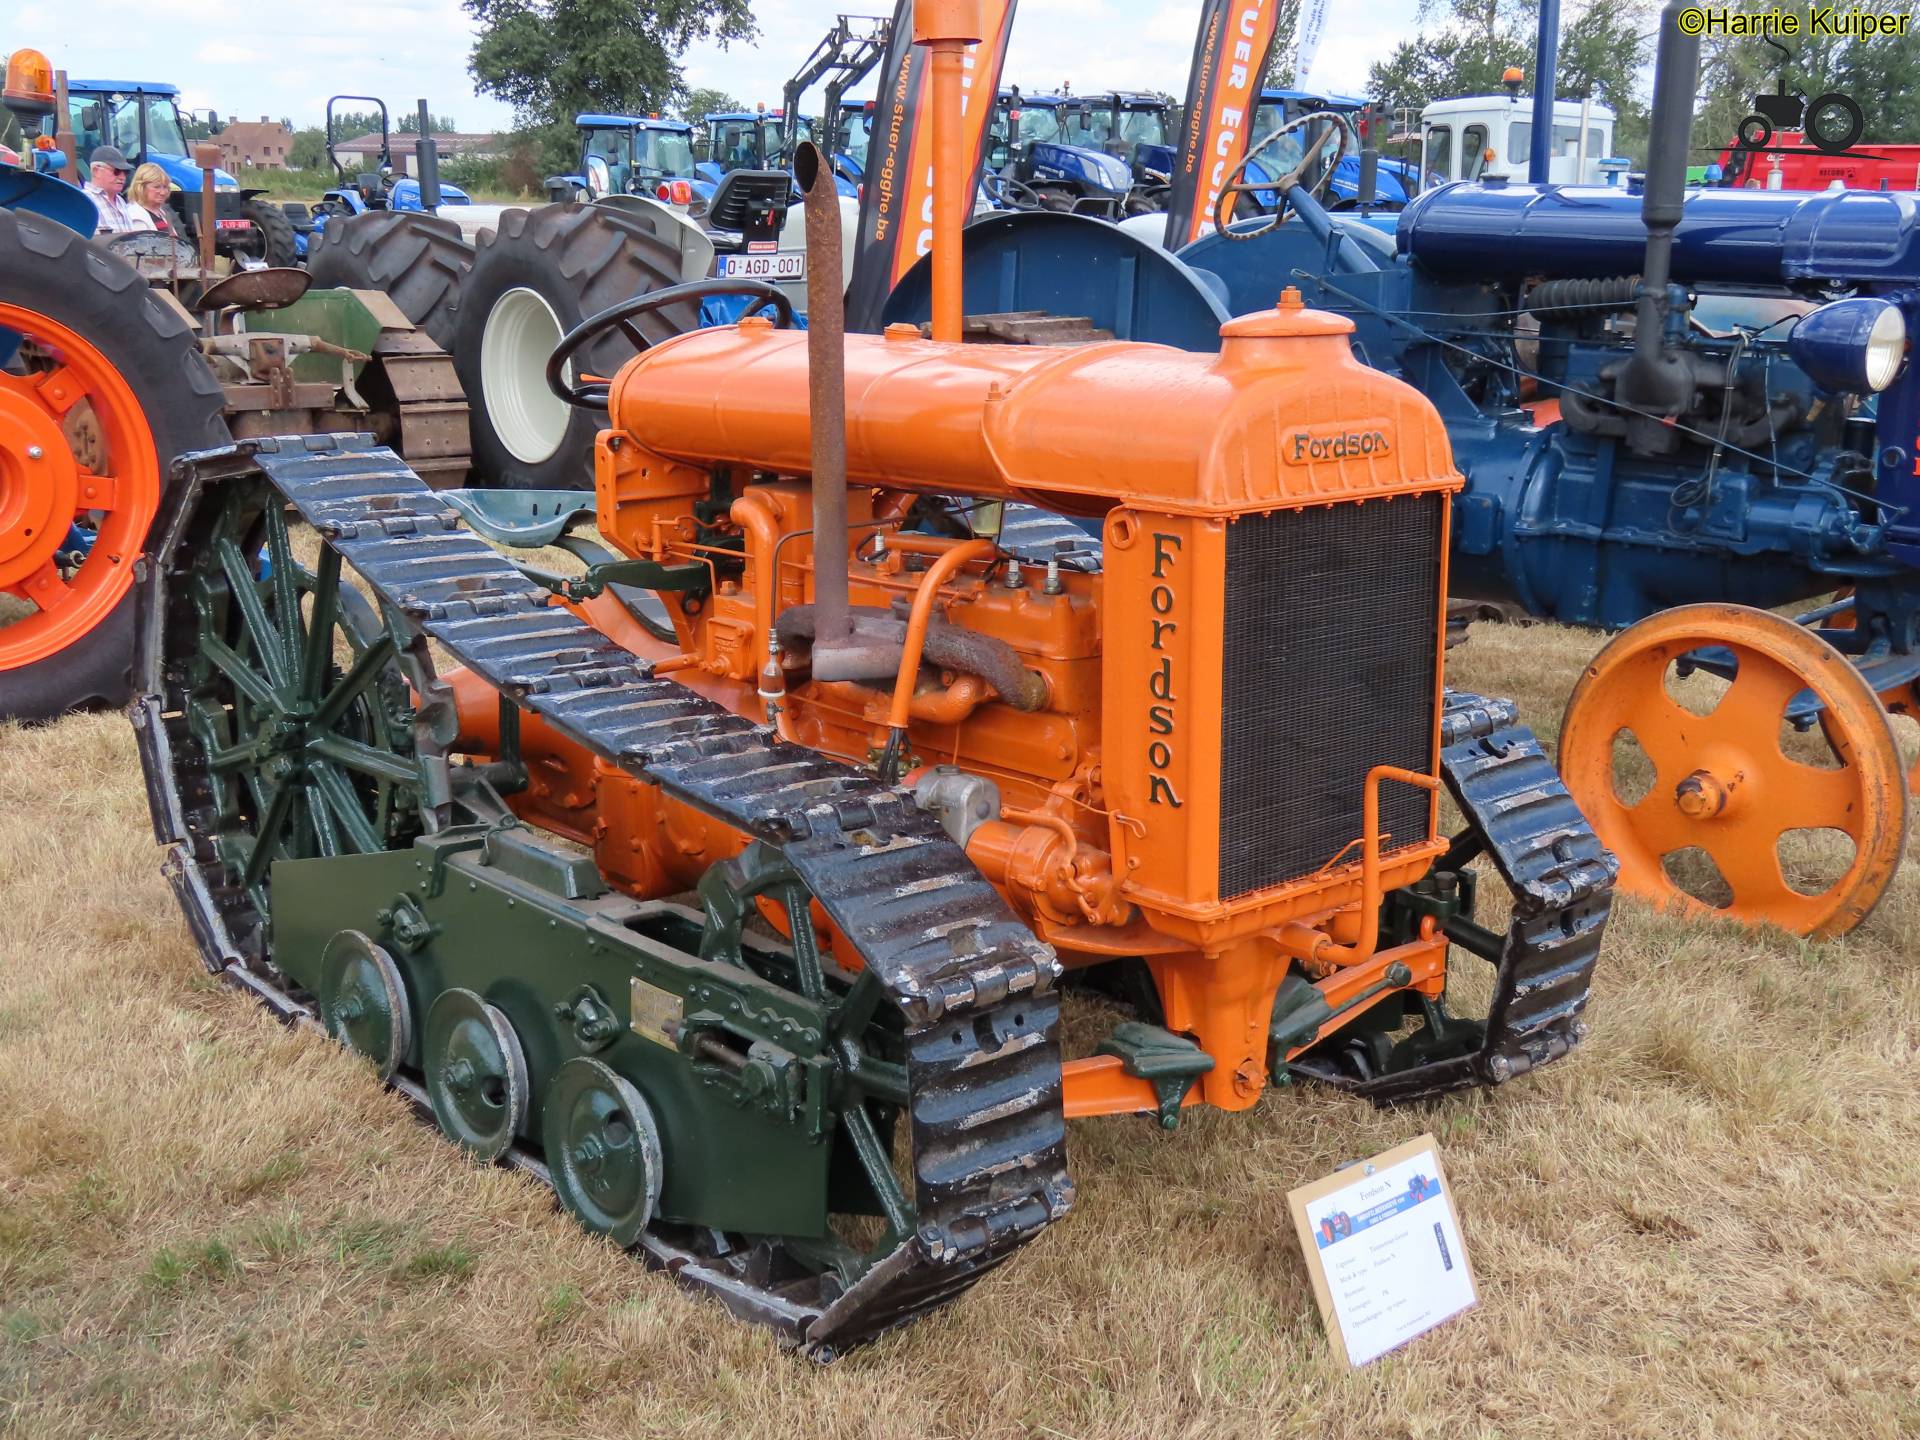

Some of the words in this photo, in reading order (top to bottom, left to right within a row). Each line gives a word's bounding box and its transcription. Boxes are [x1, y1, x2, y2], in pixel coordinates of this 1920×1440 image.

[875, 53, 912, 242] www.stuer-egghe.be
[1185, 11, 1220, 174] www.stuer-egghe.be
[1294, 431, 1389, 460] Fordson
[1148, 532, 1184, 809] Fordson
